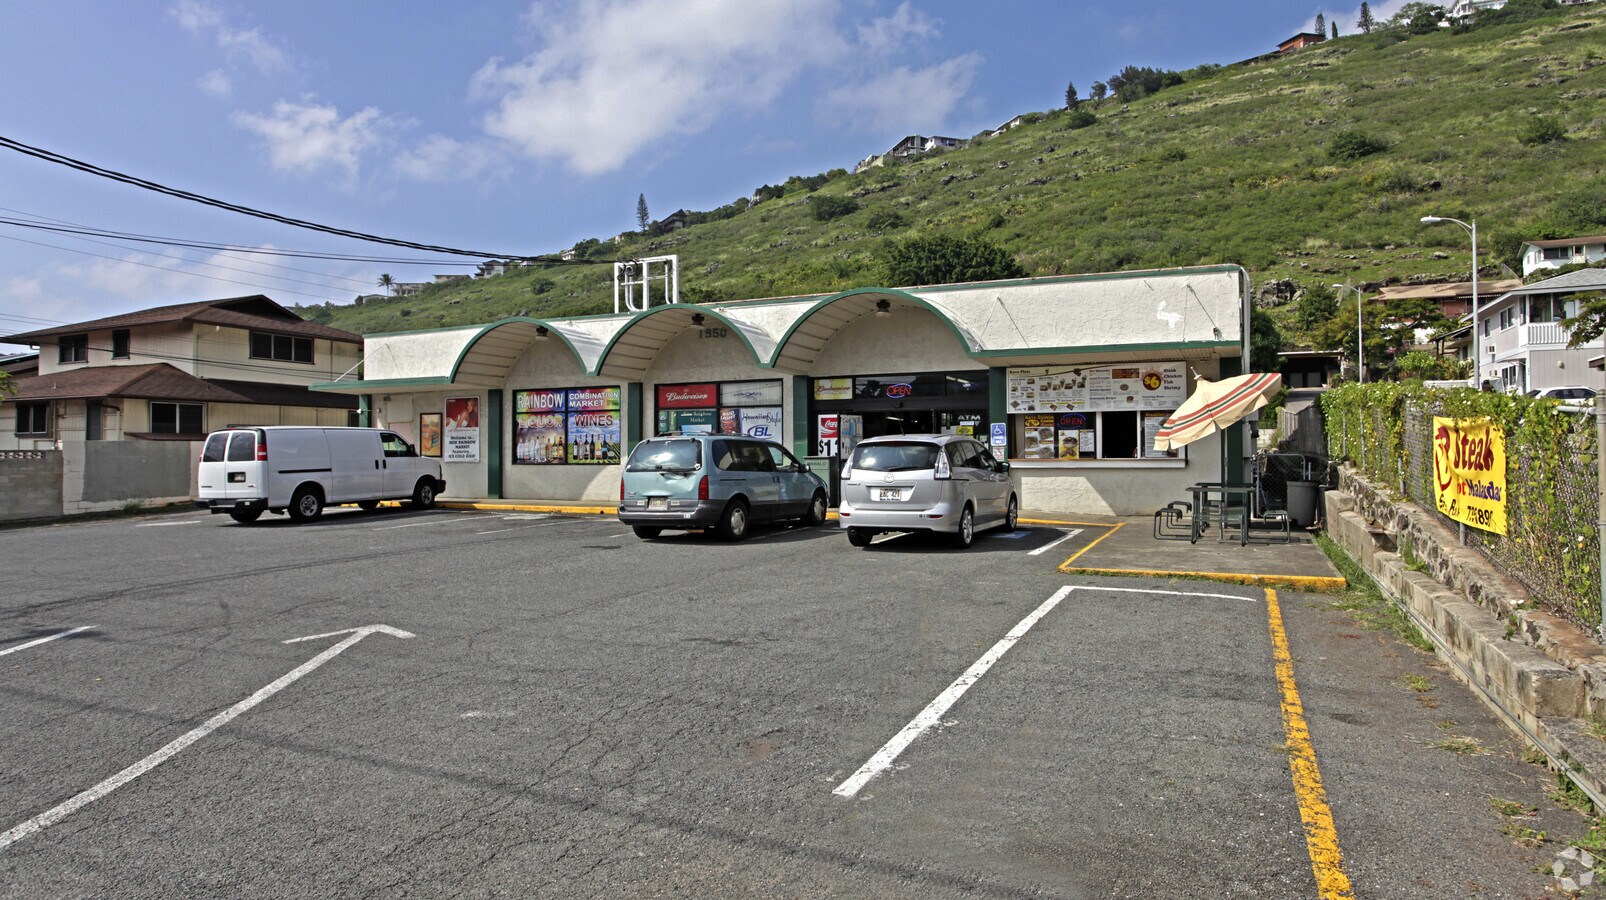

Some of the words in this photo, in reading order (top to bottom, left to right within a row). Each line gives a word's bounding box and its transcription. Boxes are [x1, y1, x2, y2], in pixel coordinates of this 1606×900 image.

[700, 328, 727, 339] 1950
[1144, 376, 1160, 388] $6
[886, 385, 911, 395] OPEN
[518, 394, 563, 409] RAINBOW
[569, 392, 619, 400] COMBINATION
[666, 392, 708, 402] Budweiser
[518, 413, 563, 428] LIQUOR
[574, 414, 613, 428] WINES
[754, 427, 772, 436] BL
[1453, 426, 1495, 471] Steak
